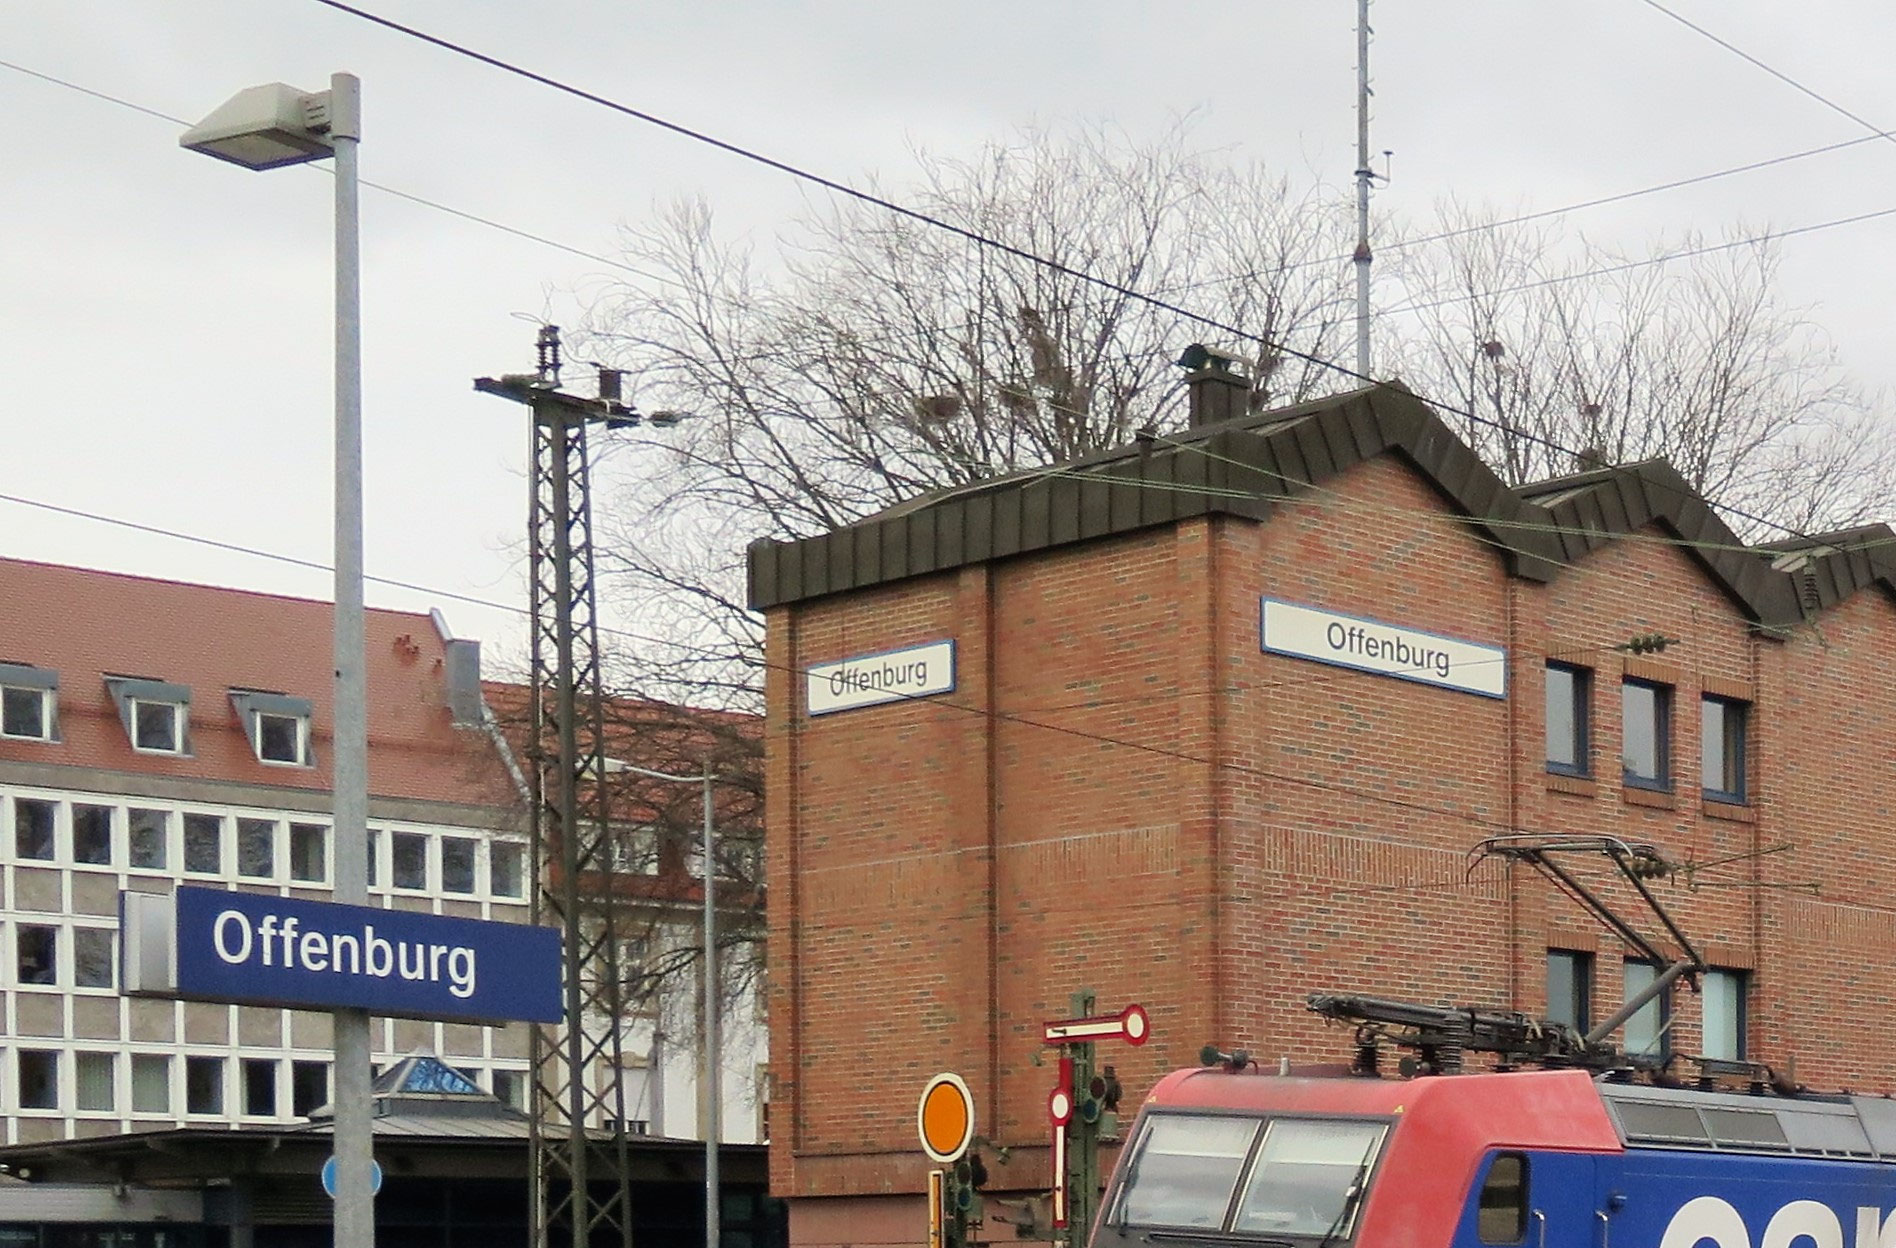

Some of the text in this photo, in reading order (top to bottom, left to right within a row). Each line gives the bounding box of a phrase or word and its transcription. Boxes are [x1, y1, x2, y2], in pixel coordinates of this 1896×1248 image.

[1327, 622, 1450, 678] Offenburg
[829, 660, 928, 697] Offenburg
[213, 909, 476, 999] Offenburg
